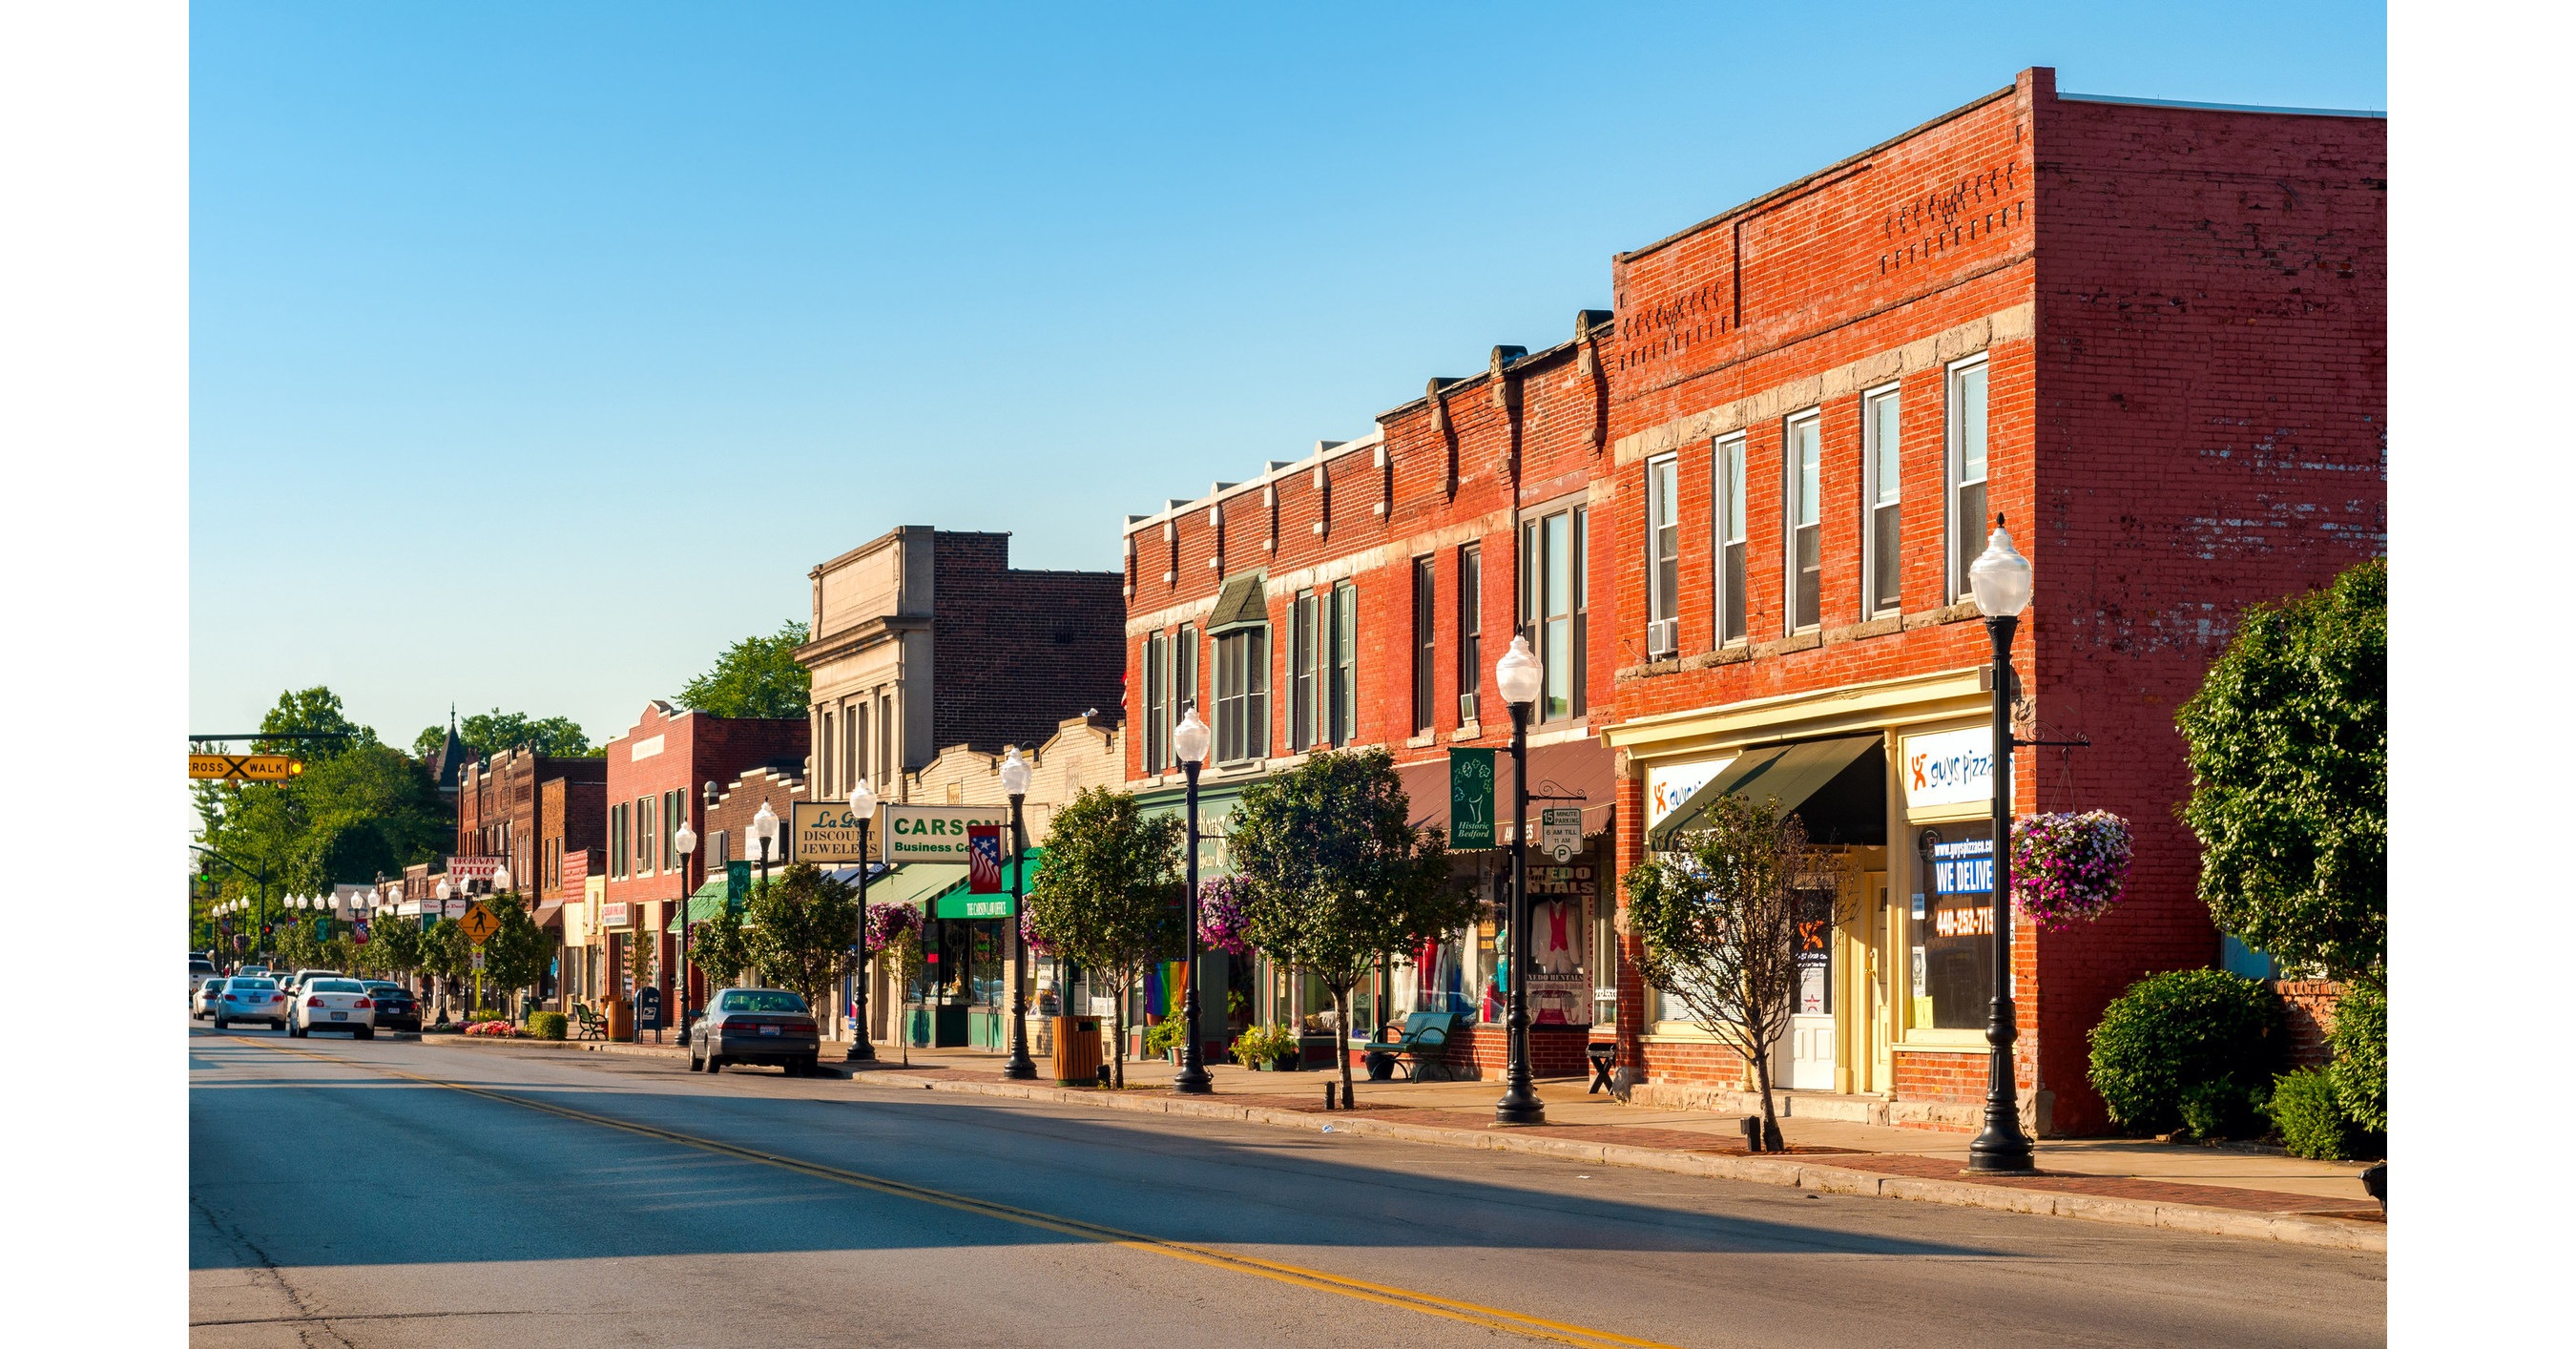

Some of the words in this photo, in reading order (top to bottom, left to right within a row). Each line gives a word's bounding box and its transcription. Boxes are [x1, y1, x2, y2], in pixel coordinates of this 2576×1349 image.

[189, 762, 223, 772] ROSS
[250, 763, 282, 773] WALK
[1930, 757, 1960, 788] guys
[1963, 750, 1993, 784] pizza
[811, 811, 837, 828] La
[1543, 811, 1553, 823] 15
[1458, 821, 1489, 830] Historic
[1458, 829, 1489, 839] Bedford
[801, 843, 878, 854] JEWELES
[894, 841, 952, 853] Business
[1934, 838, 1993, 860] www.guyspizzaco.co
[1558, 849, 1567, 859] P
[1527, 867, 1591, 880] XEDO
[1935, 861, 1954, 893] WE
[1956, 860, 1993, 892] DELIVE
[1527, 882, 1594, 894] NTALS
[1936, 906, 1993, 937] 440-252-715
